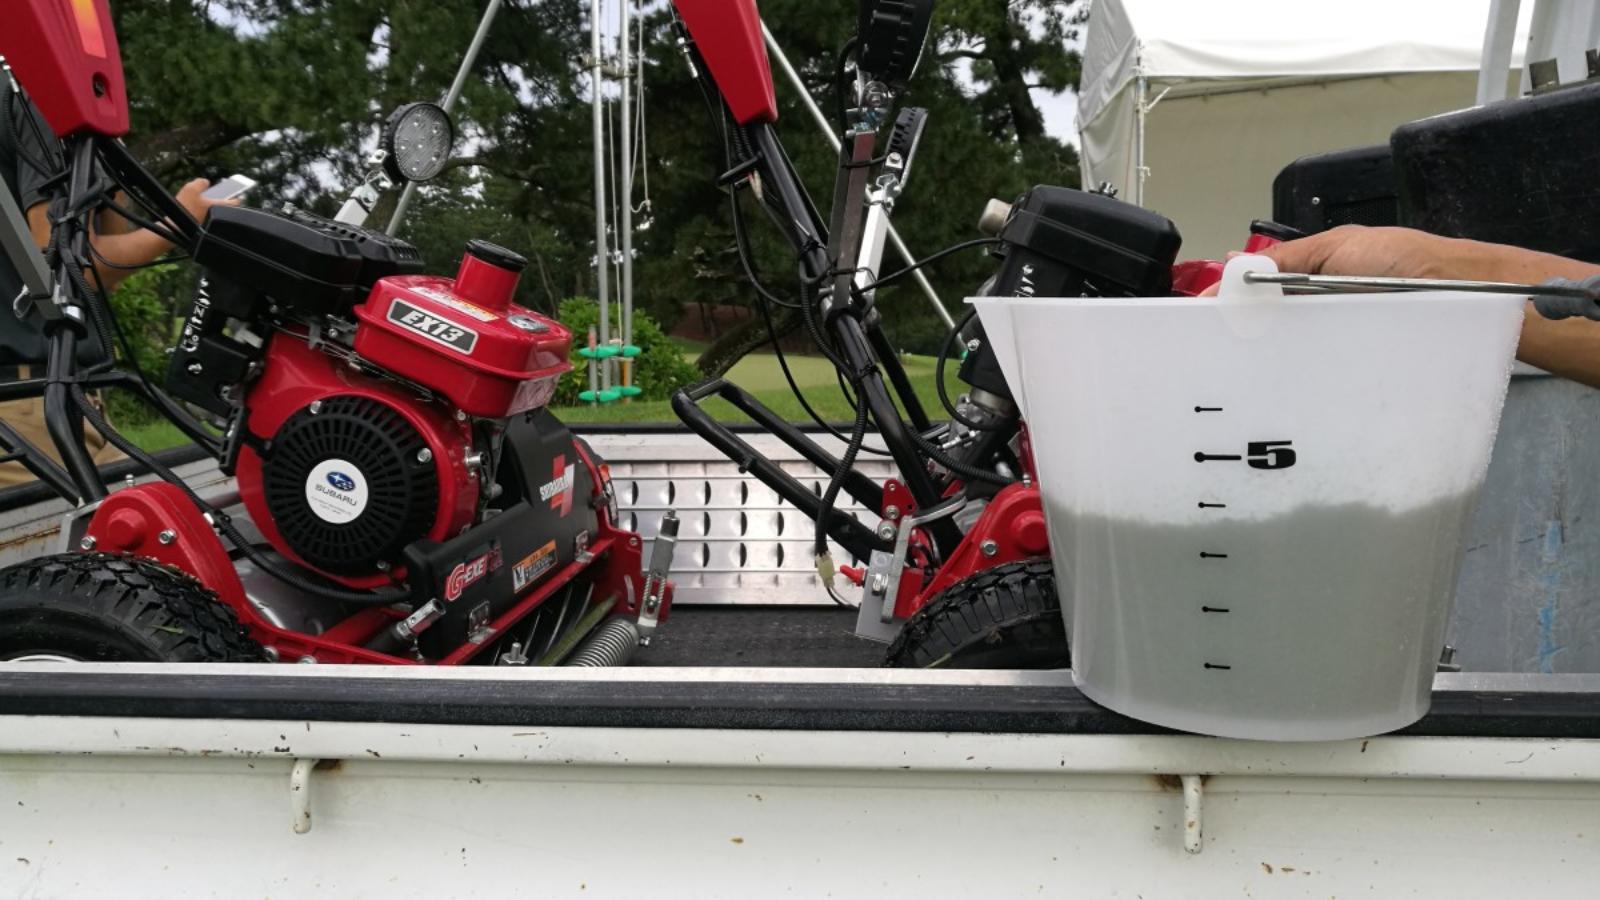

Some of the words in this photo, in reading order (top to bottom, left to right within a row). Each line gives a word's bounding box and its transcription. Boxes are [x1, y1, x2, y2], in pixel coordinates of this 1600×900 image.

[401, 310, 465, 342] EX13
[1247, 440, 1296, 470] 5
[315, 484, 357, 506] SUBARU
